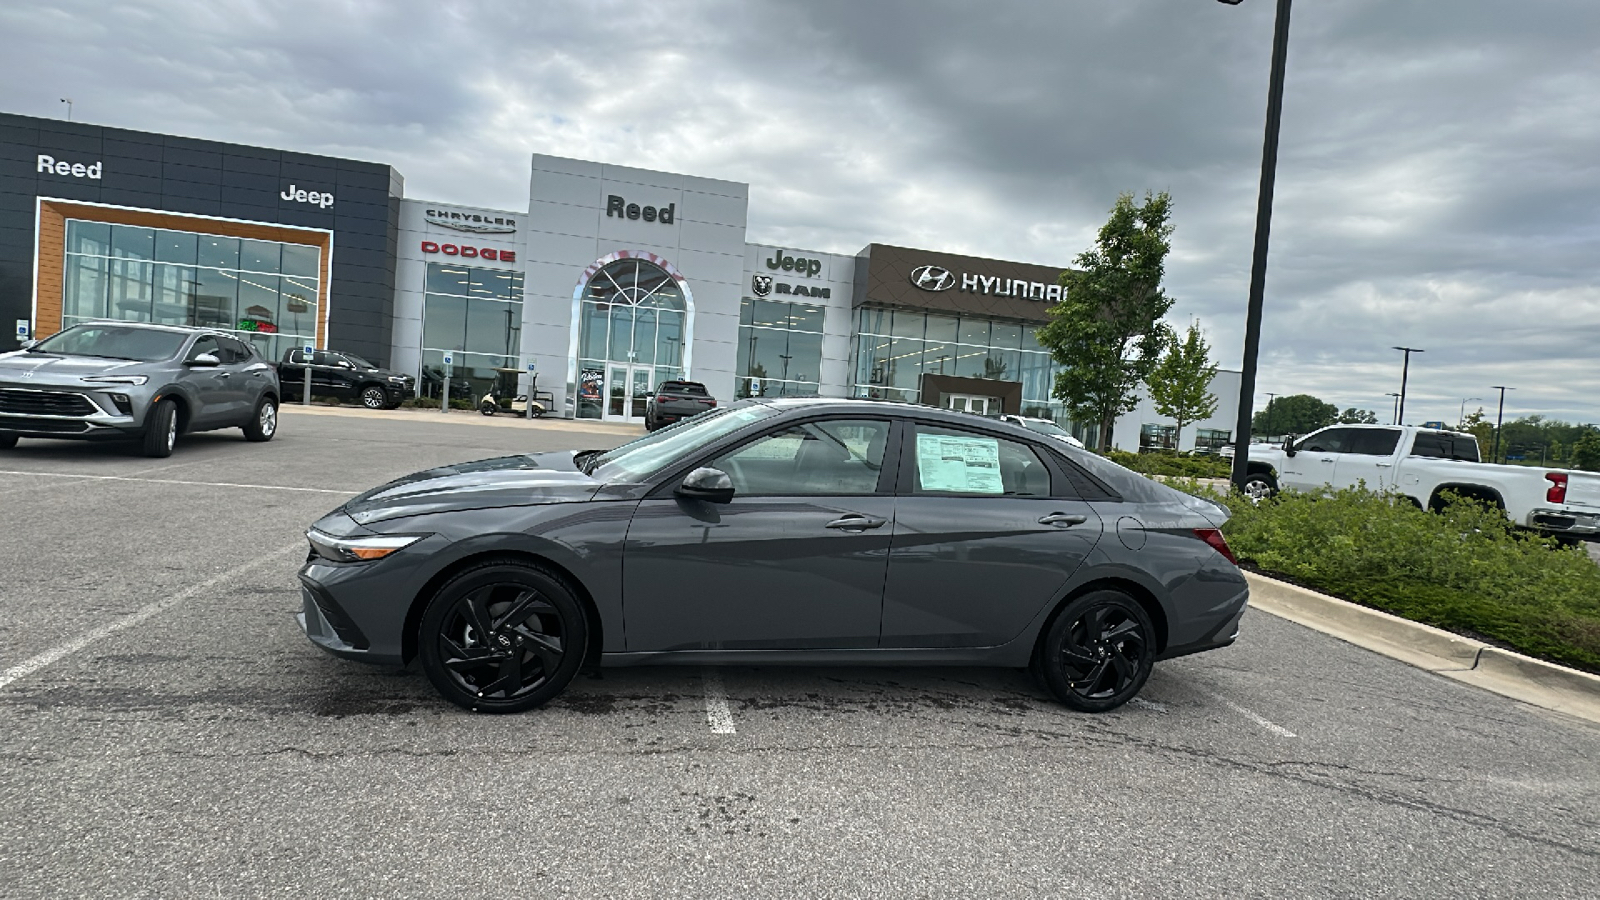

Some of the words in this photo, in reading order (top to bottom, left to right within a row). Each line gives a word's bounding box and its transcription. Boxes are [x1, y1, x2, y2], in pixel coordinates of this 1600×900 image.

[37, 154, 103, 179] Reed
[280, 184, 334, 209] Jeep
[425, 209, 515, 226] CHRYSLER
[606, 194, 675, 225] Reed
[421, 241, 516, 262] DODGE
[766, 249, 821, 278] Jeep
[775, 282, 831, 299] RAM
